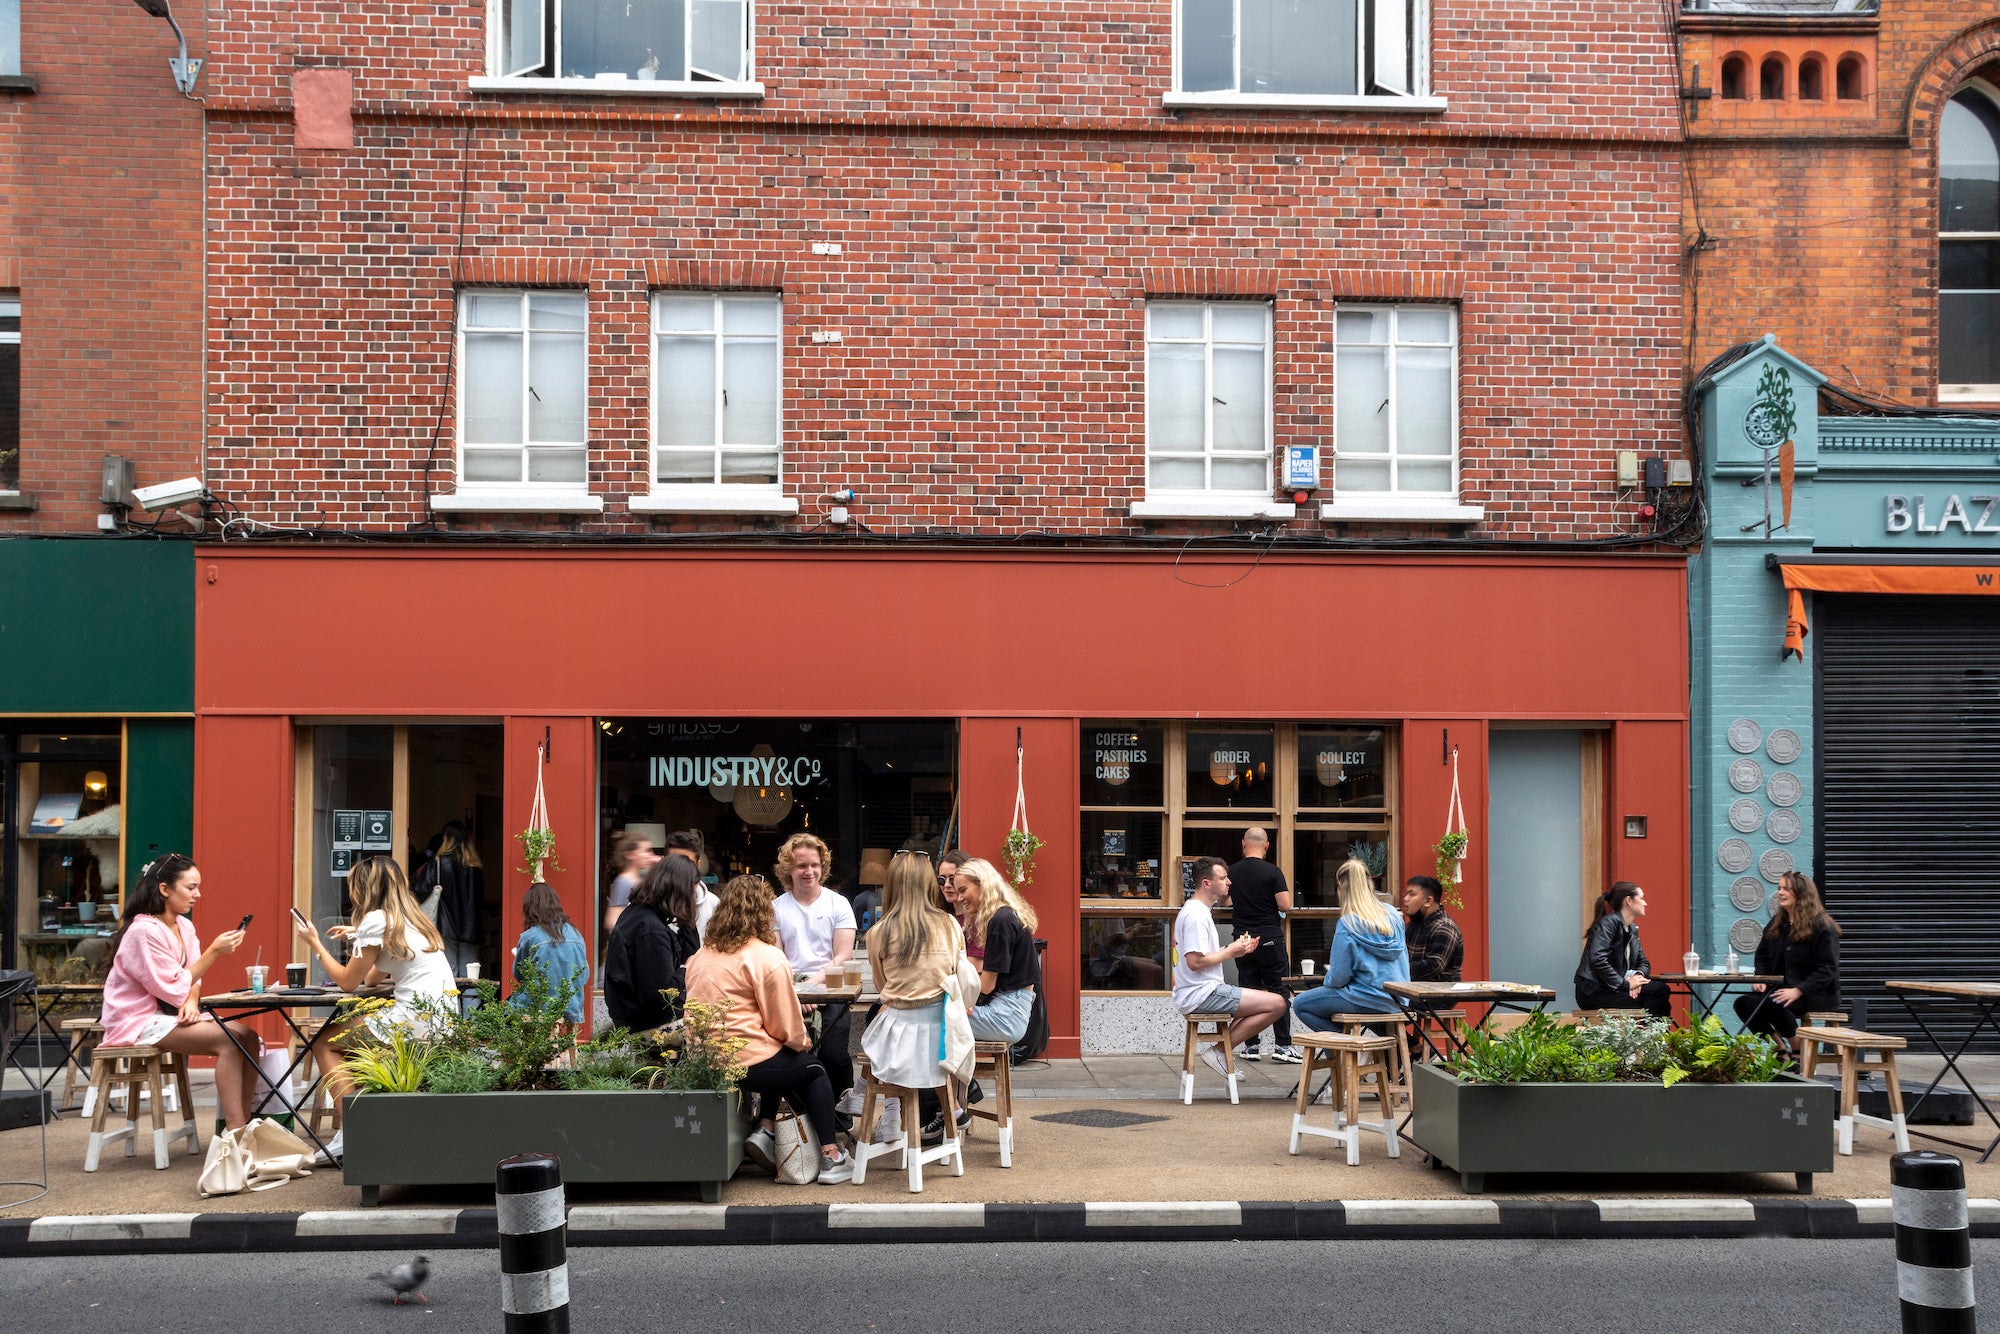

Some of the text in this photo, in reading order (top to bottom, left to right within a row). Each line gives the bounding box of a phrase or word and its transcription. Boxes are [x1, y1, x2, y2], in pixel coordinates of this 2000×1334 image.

[1885, 494, 2000, 533] BLAZ
[1975, 573, 2000, 587] W
[1095, 732, 1138, 746] COFFEE
[1095, 749, 1147, 763] PASTRIES
[1213, 750, 1251, 764] ORDER
[1319, 751, 1366, 765] COLLECT
[1095, 765, 1130, 779] CAKES
